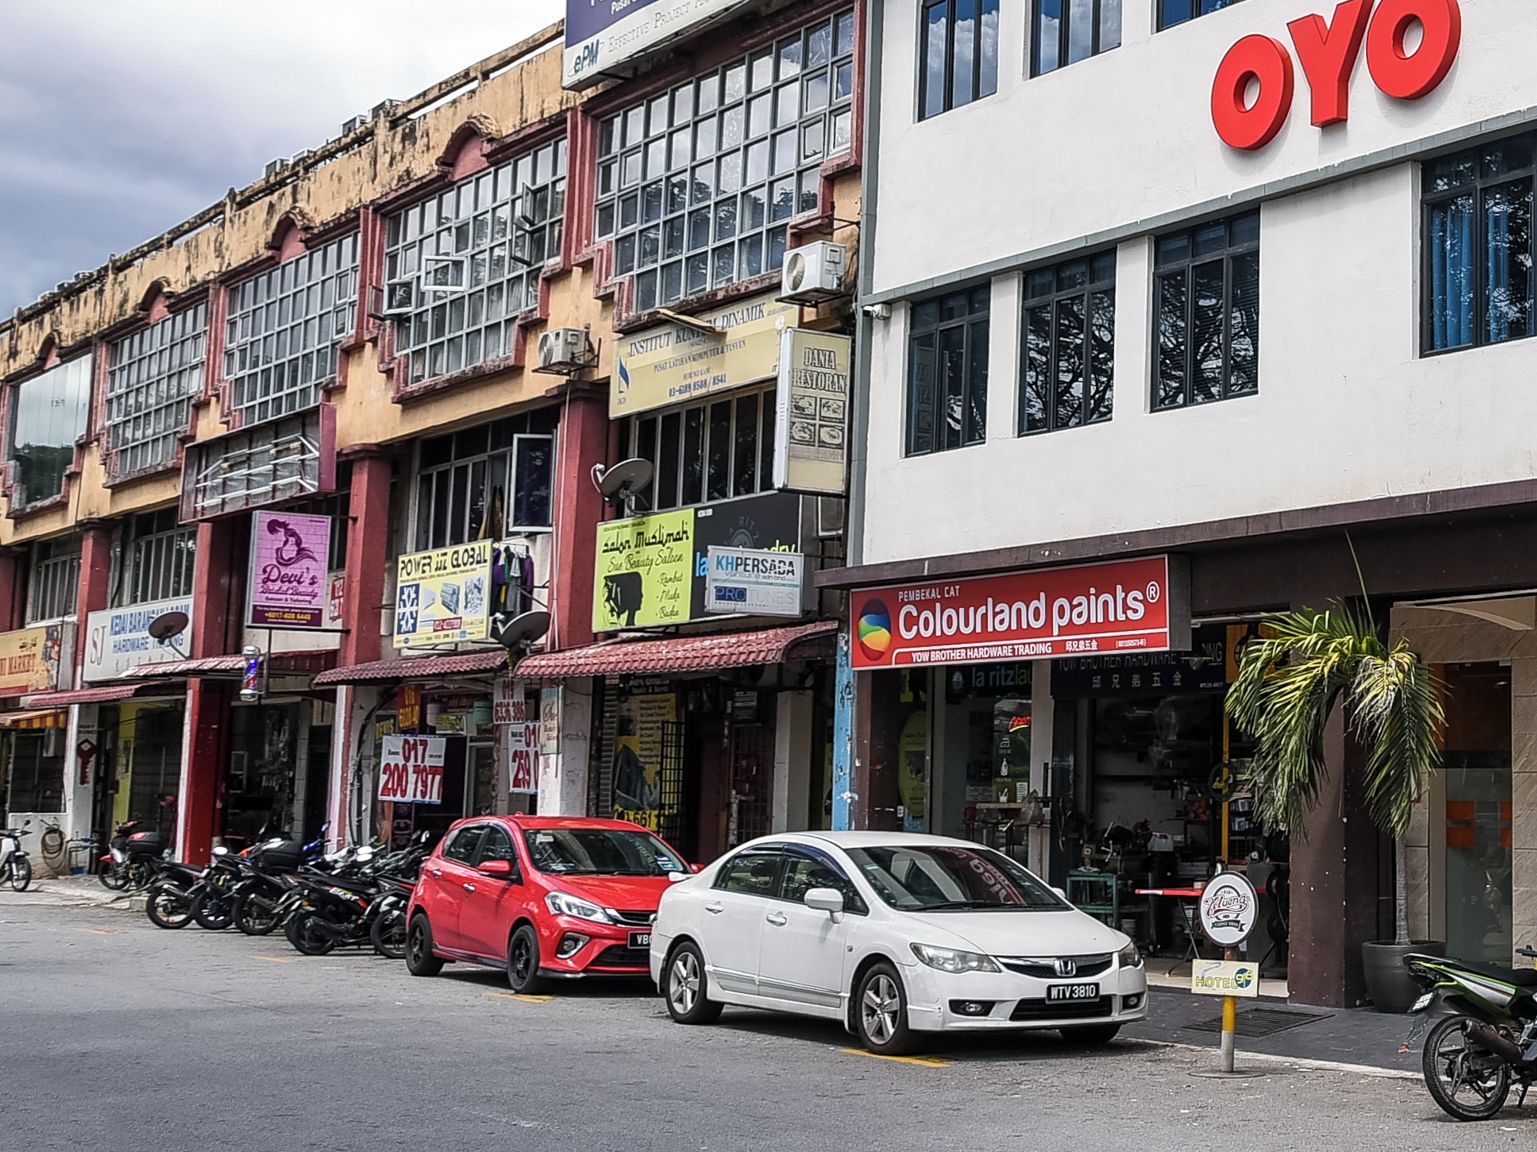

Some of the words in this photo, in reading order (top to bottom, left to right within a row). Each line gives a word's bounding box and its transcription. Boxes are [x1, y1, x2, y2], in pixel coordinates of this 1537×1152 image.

[628, 331, 672, 358] INSTITUT
[721, 303, 766, 330] DINAMIK
[804, 347, 836, 369] DANIA
[793, 368, 846, 393] RESTORAN
[400, 556, 433, 578] POWER
[450, 545, 488, 568] GLOBAL
[262, 563, 318, 585] Devi's
[899, 588, 941, 602] PEMBEKAL
[944, 585, 960, 597] CAT
[899, 591, 1046, 640] Colourland
[911, 652, 929, 663] YOW
[931, 649, 966, 662] BROTHER
[967, 645, 1013, 659] HARDWARE
[1013, 642, 1052, 657] TRADING
[402, 738, 428, 764] 017
[381, 762, 408, 798] 200
[1050, 986, 1072, 999] WTV
[1072, 984, 1096, 998] 3810
[1195, 976, 1239, 989] HOTEL
